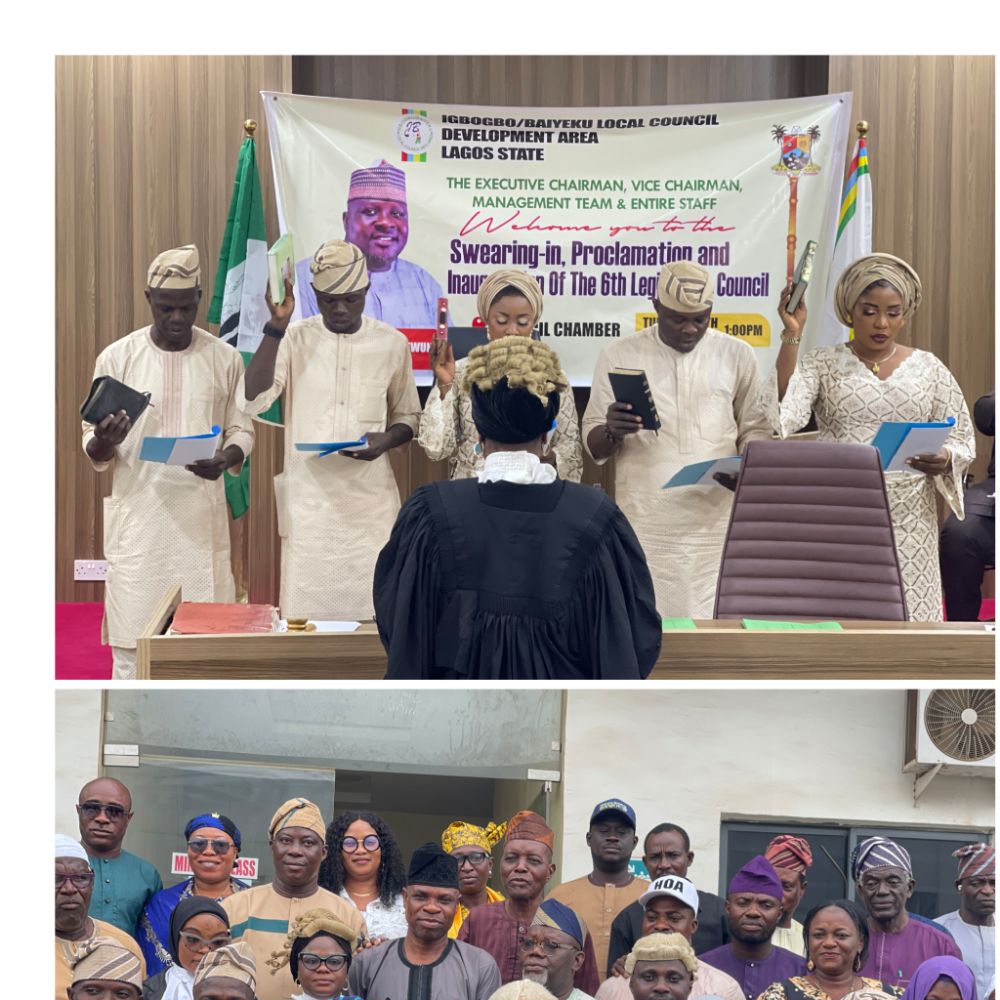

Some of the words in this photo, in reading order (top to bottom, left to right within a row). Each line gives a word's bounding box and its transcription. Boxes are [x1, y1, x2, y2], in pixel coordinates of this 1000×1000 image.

[441, 114, 593, 129] IGBOGBO/BAIYEKU
[597, 118, 645, 129] LOCAL
[649, 114, 719, 127] COUNCIL
[441, 128, 555, 144] DEVELOPMENT
[557, 131, 599, 144] AREA
[441, 146, 494, 160] LAGOS
[497, 147, 545, 161] STATE
[446, 177, 471, 189] THE
[475, 178, 545, 190] EXECUTIVE
[549, 179, 627, 193] CHAIRMAN,
[631, 180, 661, 191] VICE
[664, 179, 743, 194] CHAIRMAN,
[472, 196, 571, 209] MANAGEMENT
[575, 197, 613, 209] TEAM
[617, 198, 627, 209] &
[631, 198, 675, 209] ENTIRE
[679, 197, 718, 209] STAFF
[609, 225, 655, 237] you
[653, 215, 685, 232] to
[681, 215, 736, 232] the
[450, 239, 566, 269] Swearing-in,
[571, 241, 692, 266] Proclamation
[698, 241, 730, 266] and
[549, 271, 566, 296] Of
[570, 271, 597, 296] The
[601, 272, 627, 297] 6th
[717, 272, 769, 297] Council
[553, 321, 621, 337] CHAMBER
[724, 324, 763, 336] 1:00PM
[654, 878, 684, 893] HOA
